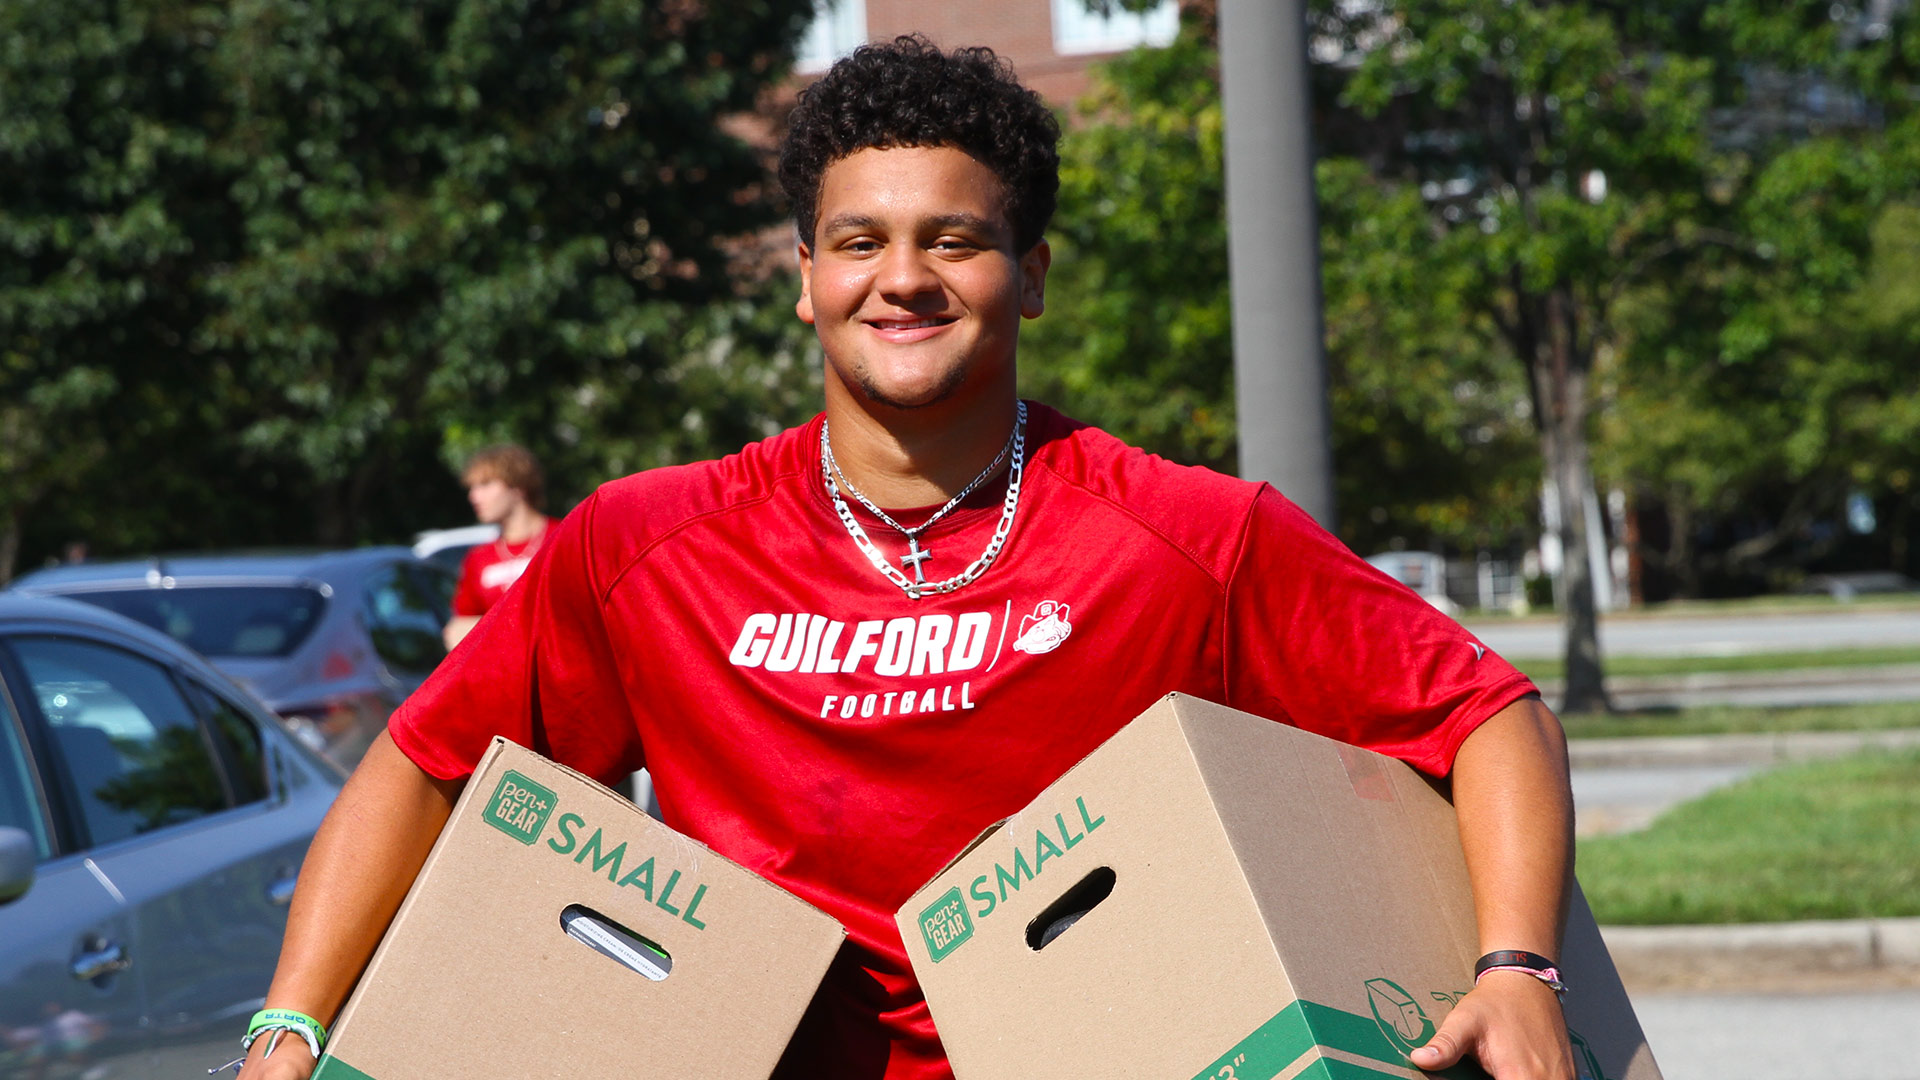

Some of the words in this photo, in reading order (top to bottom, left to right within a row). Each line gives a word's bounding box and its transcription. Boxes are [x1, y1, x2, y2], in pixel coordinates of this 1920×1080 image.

[729, 612, 992, 677] GUILFORD
[820, 681, 975, 719] FOOTBALL
[496, 797, 538, 834] GEAR
[548, 813, 709, 930] SMALL
[970, 797, 1106, 917] SMALL
[933, 913, 967, 950] GEAR
